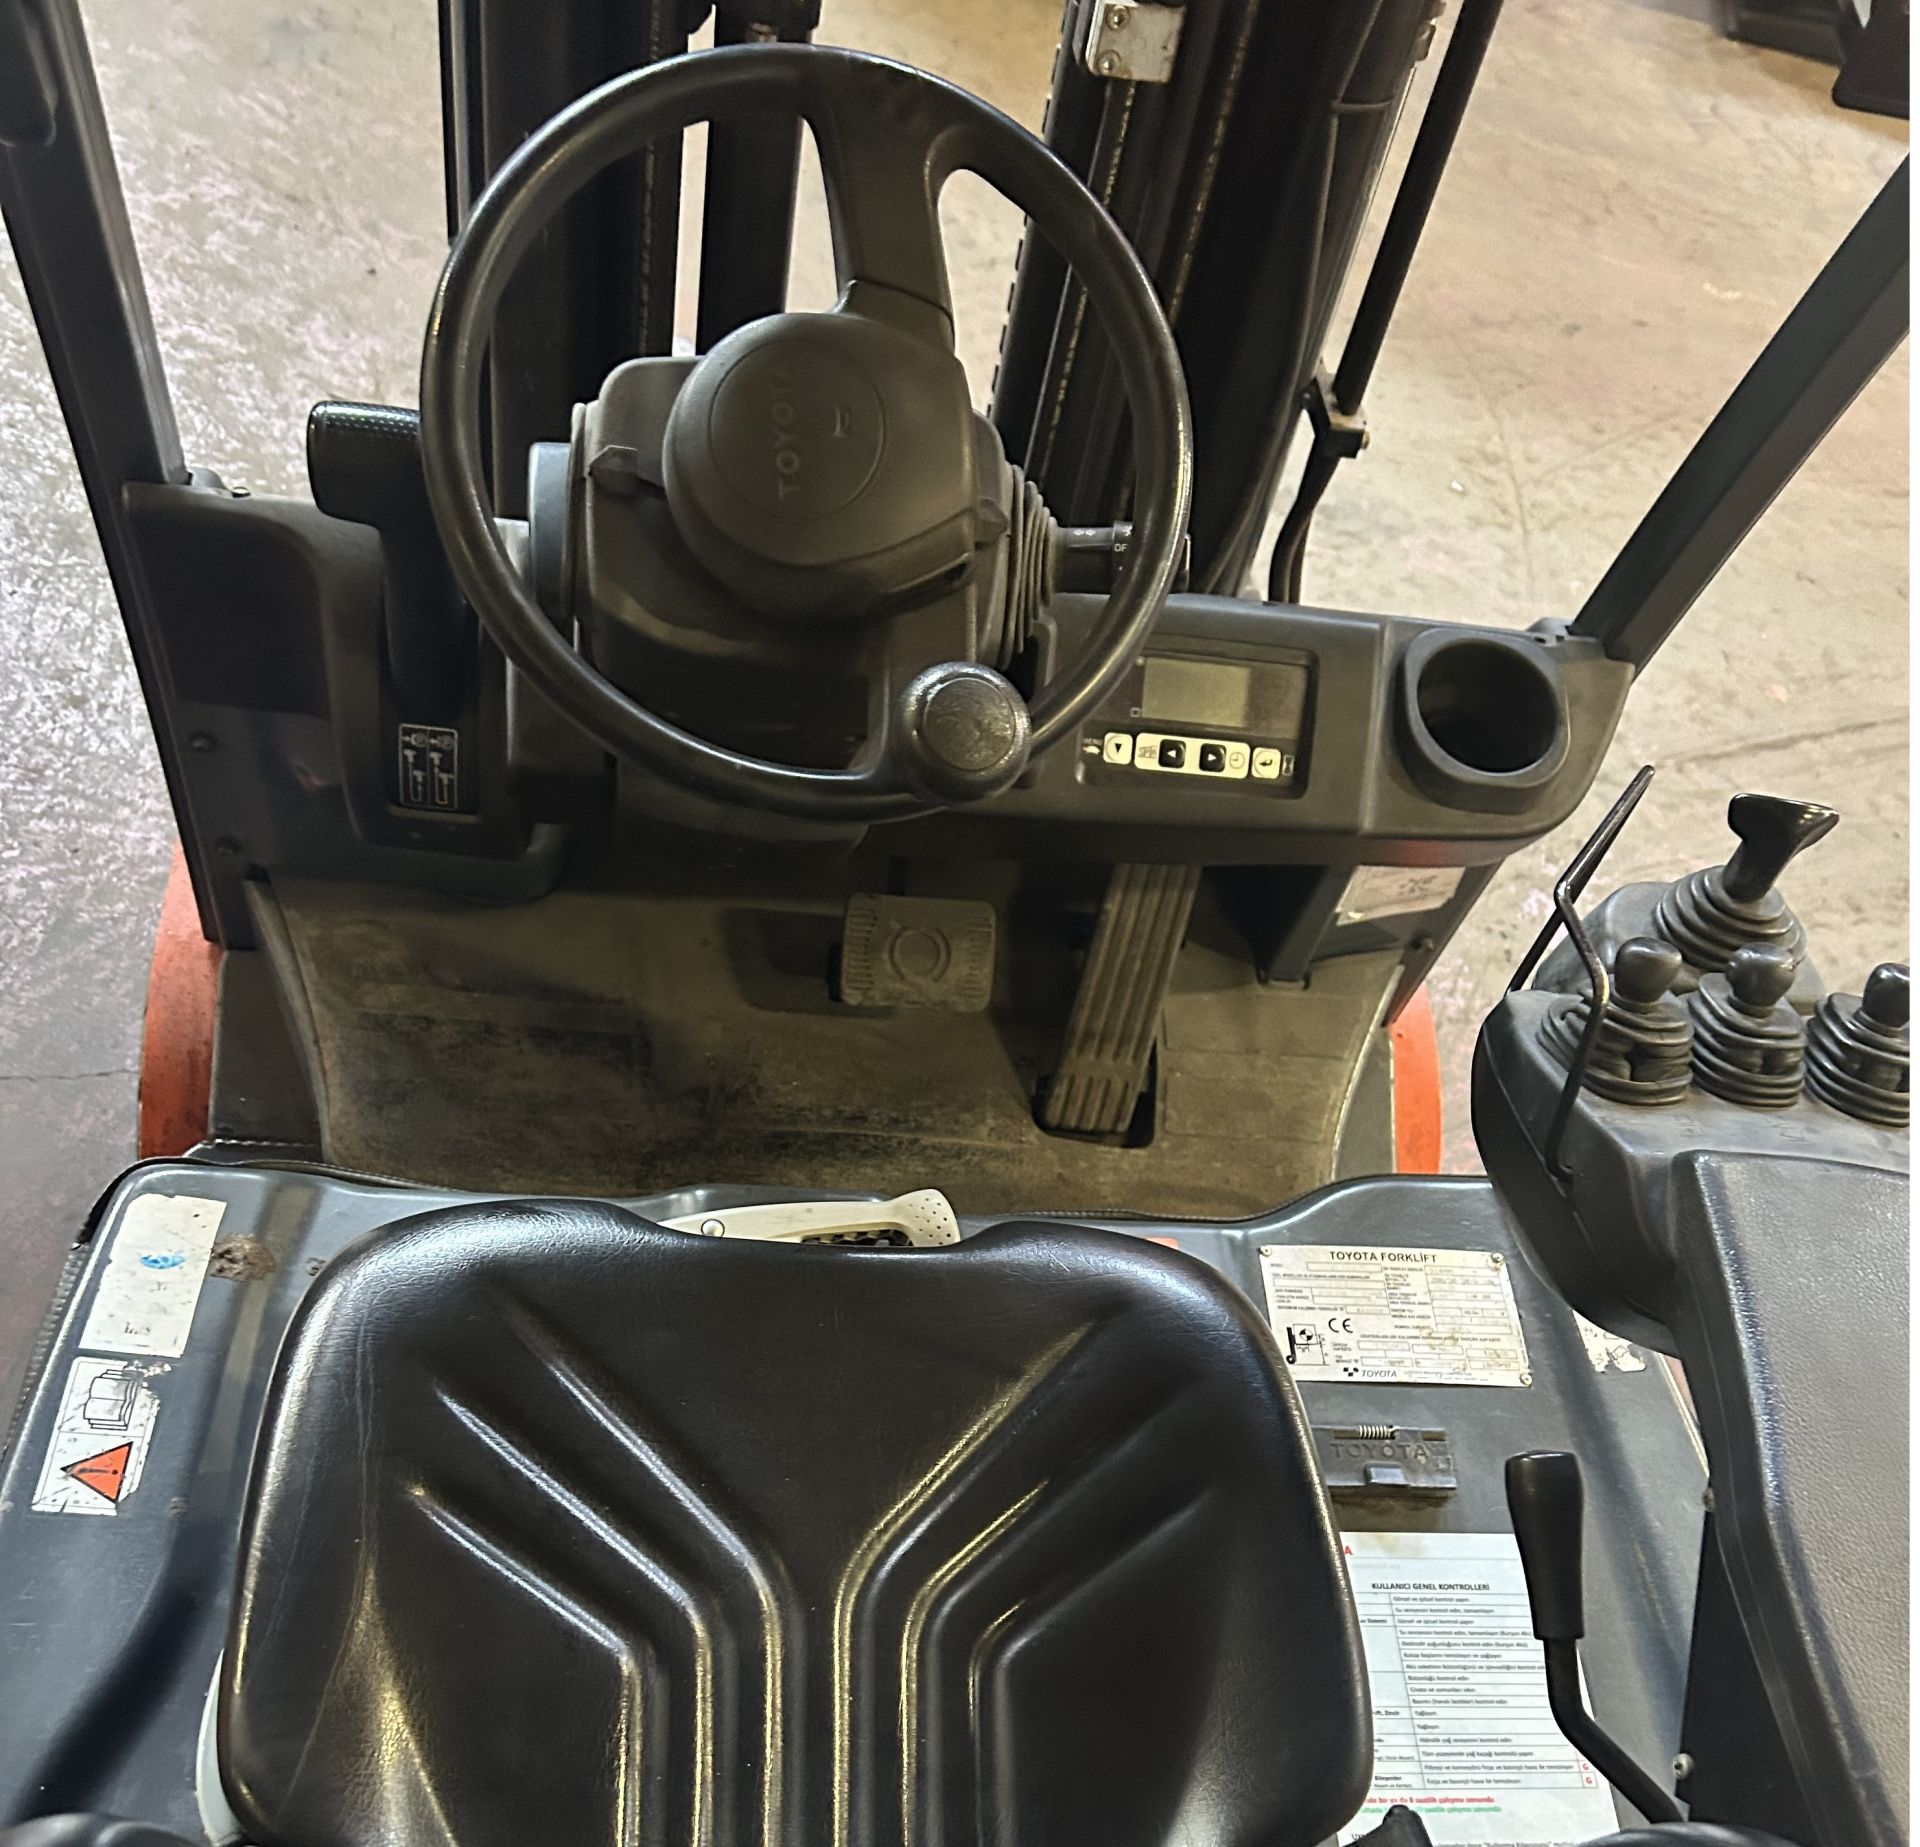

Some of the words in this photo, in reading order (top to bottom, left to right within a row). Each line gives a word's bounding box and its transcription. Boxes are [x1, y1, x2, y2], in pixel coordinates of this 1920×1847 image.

[1330, 1251, 1377, 1261] TOYOTA
[1381, 1251, 1437, 1262] FORKLİFT
[1361, 1369, 1397, 1378] TOYOTA
[1330, 1443, 1428, 1459] TOYOTA
[1439, 1583, 1490, 1591] KONTROLLERİ
